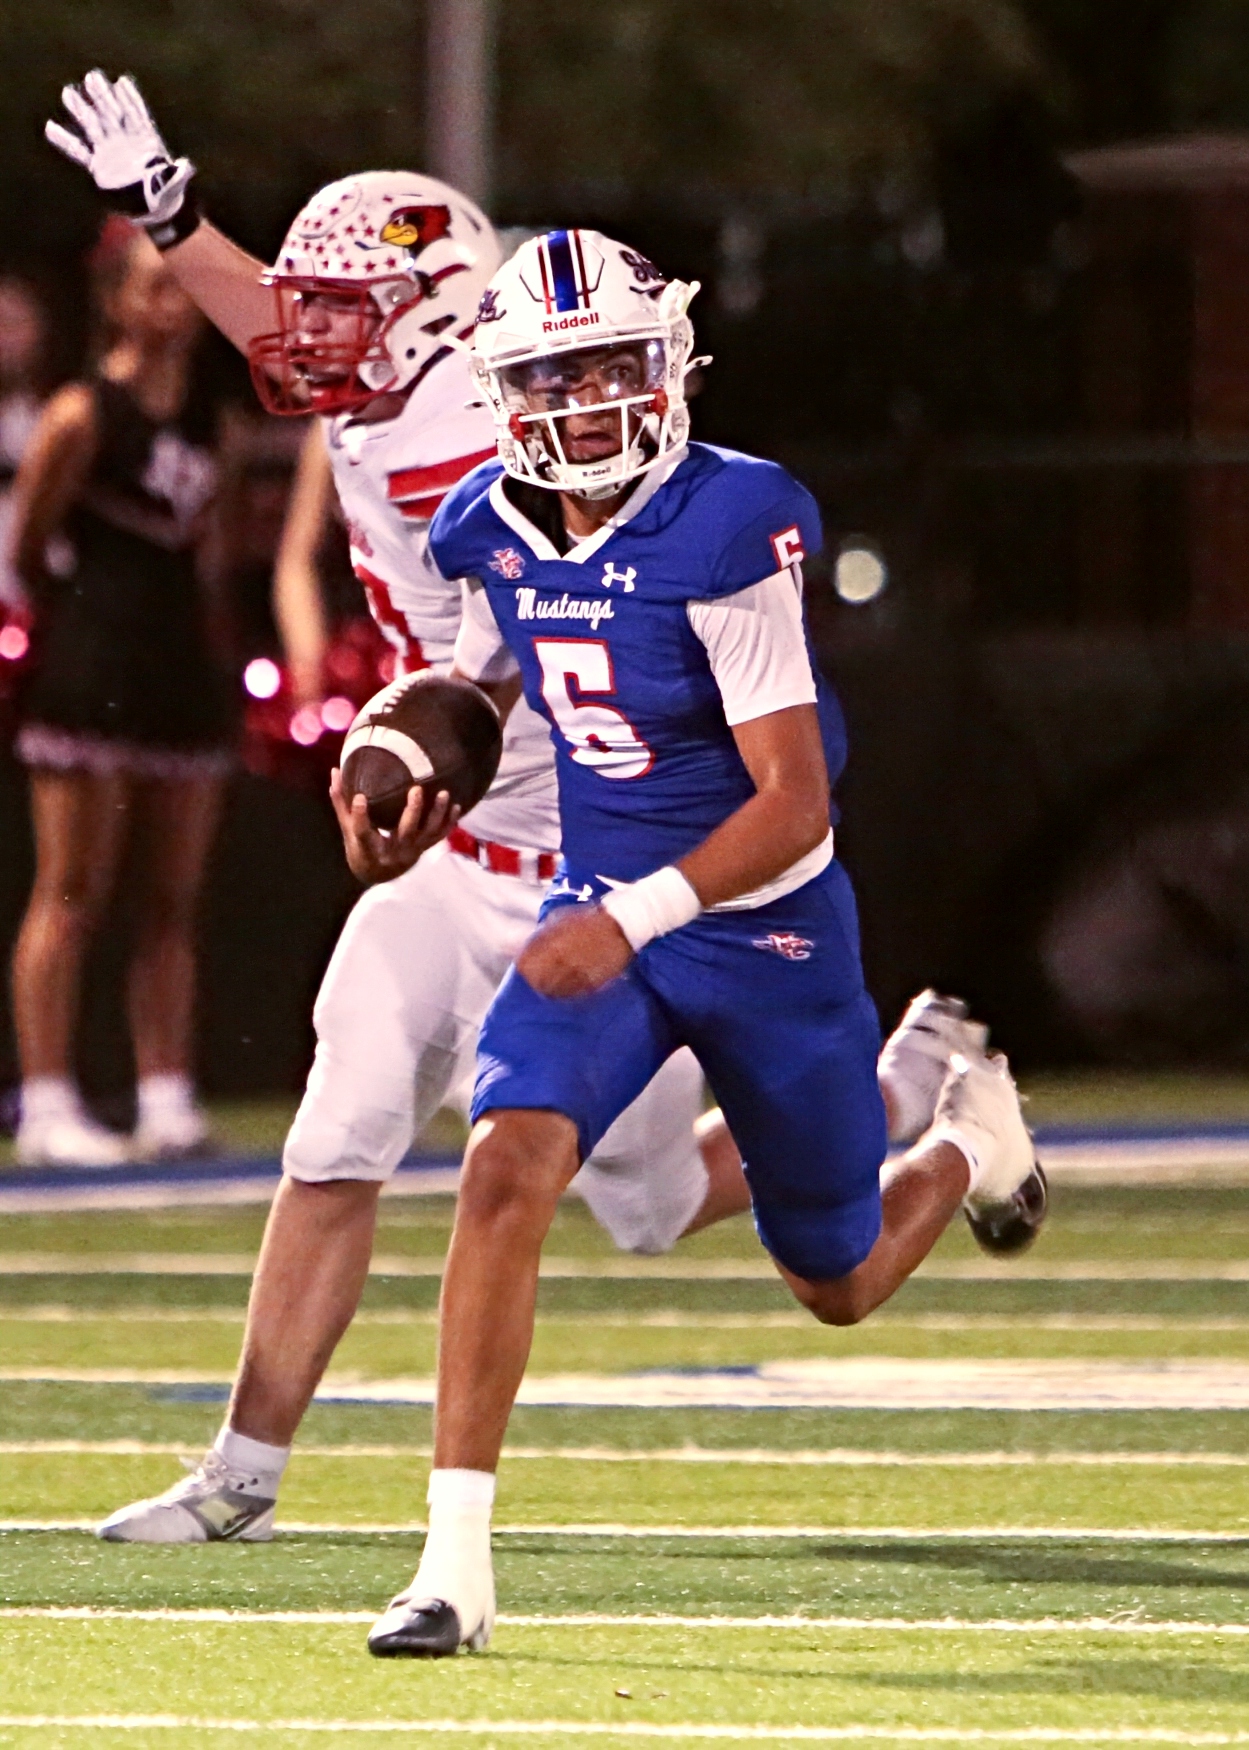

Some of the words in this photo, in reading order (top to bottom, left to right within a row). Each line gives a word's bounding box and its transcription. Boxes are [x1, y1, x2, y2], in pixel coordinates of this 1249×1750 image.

[542, 312, 600, 333] Riddell
[515, 587, 615, 631] Mustangs
[532, 636, 655, 780] 6
